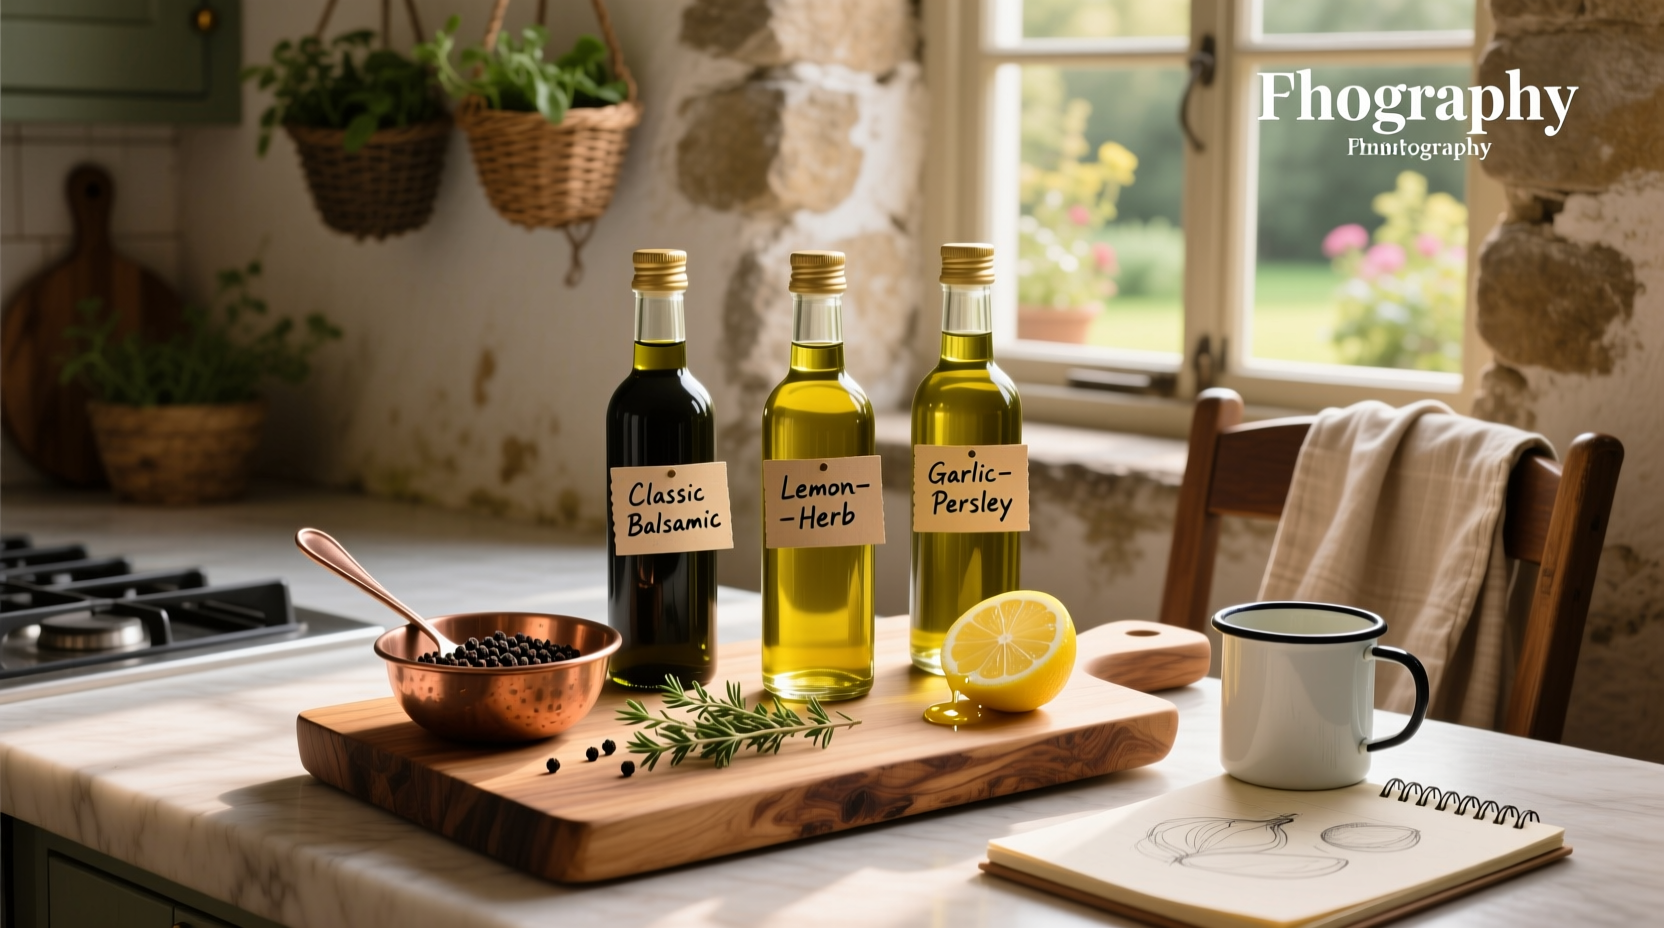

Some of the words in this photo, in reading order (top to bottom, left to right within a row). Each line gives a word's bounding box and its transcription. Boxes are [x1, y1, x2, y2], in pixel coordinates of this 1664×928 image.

[928, 461, 1012, 485] Garlic-
[628, 482, 705, 507] Classic
[781, 475, 870, 500] Lemon-
[931, 490, 1013, 522] Persley
[627, 510, 722, 537] Balsamic
